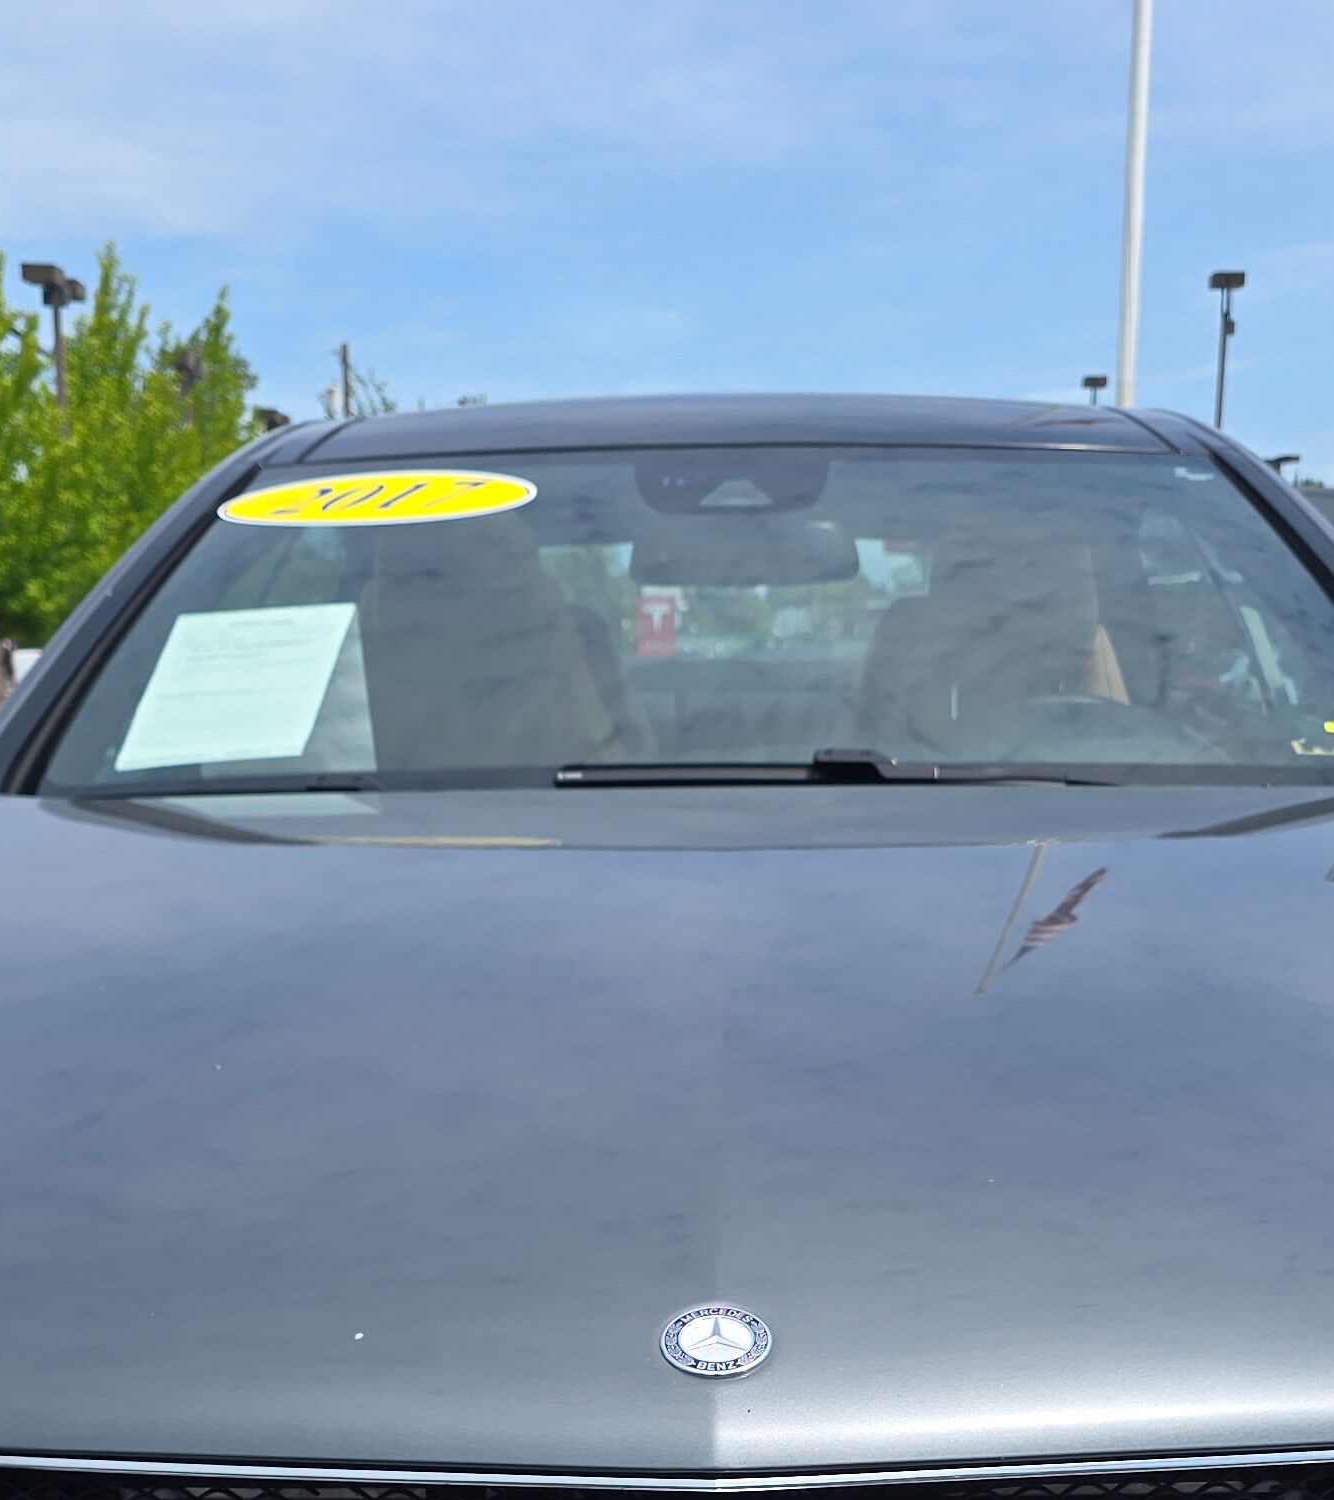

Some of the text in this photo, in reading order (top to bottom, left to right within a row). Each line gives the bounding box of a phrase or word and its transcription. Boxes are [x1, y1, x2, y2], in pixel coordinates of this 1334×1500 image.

[271, 482, 489, 514] 2017
[681, 1307, 754, 1324] MERCEDES
[696, 1360, 737, 1371] BENZ
